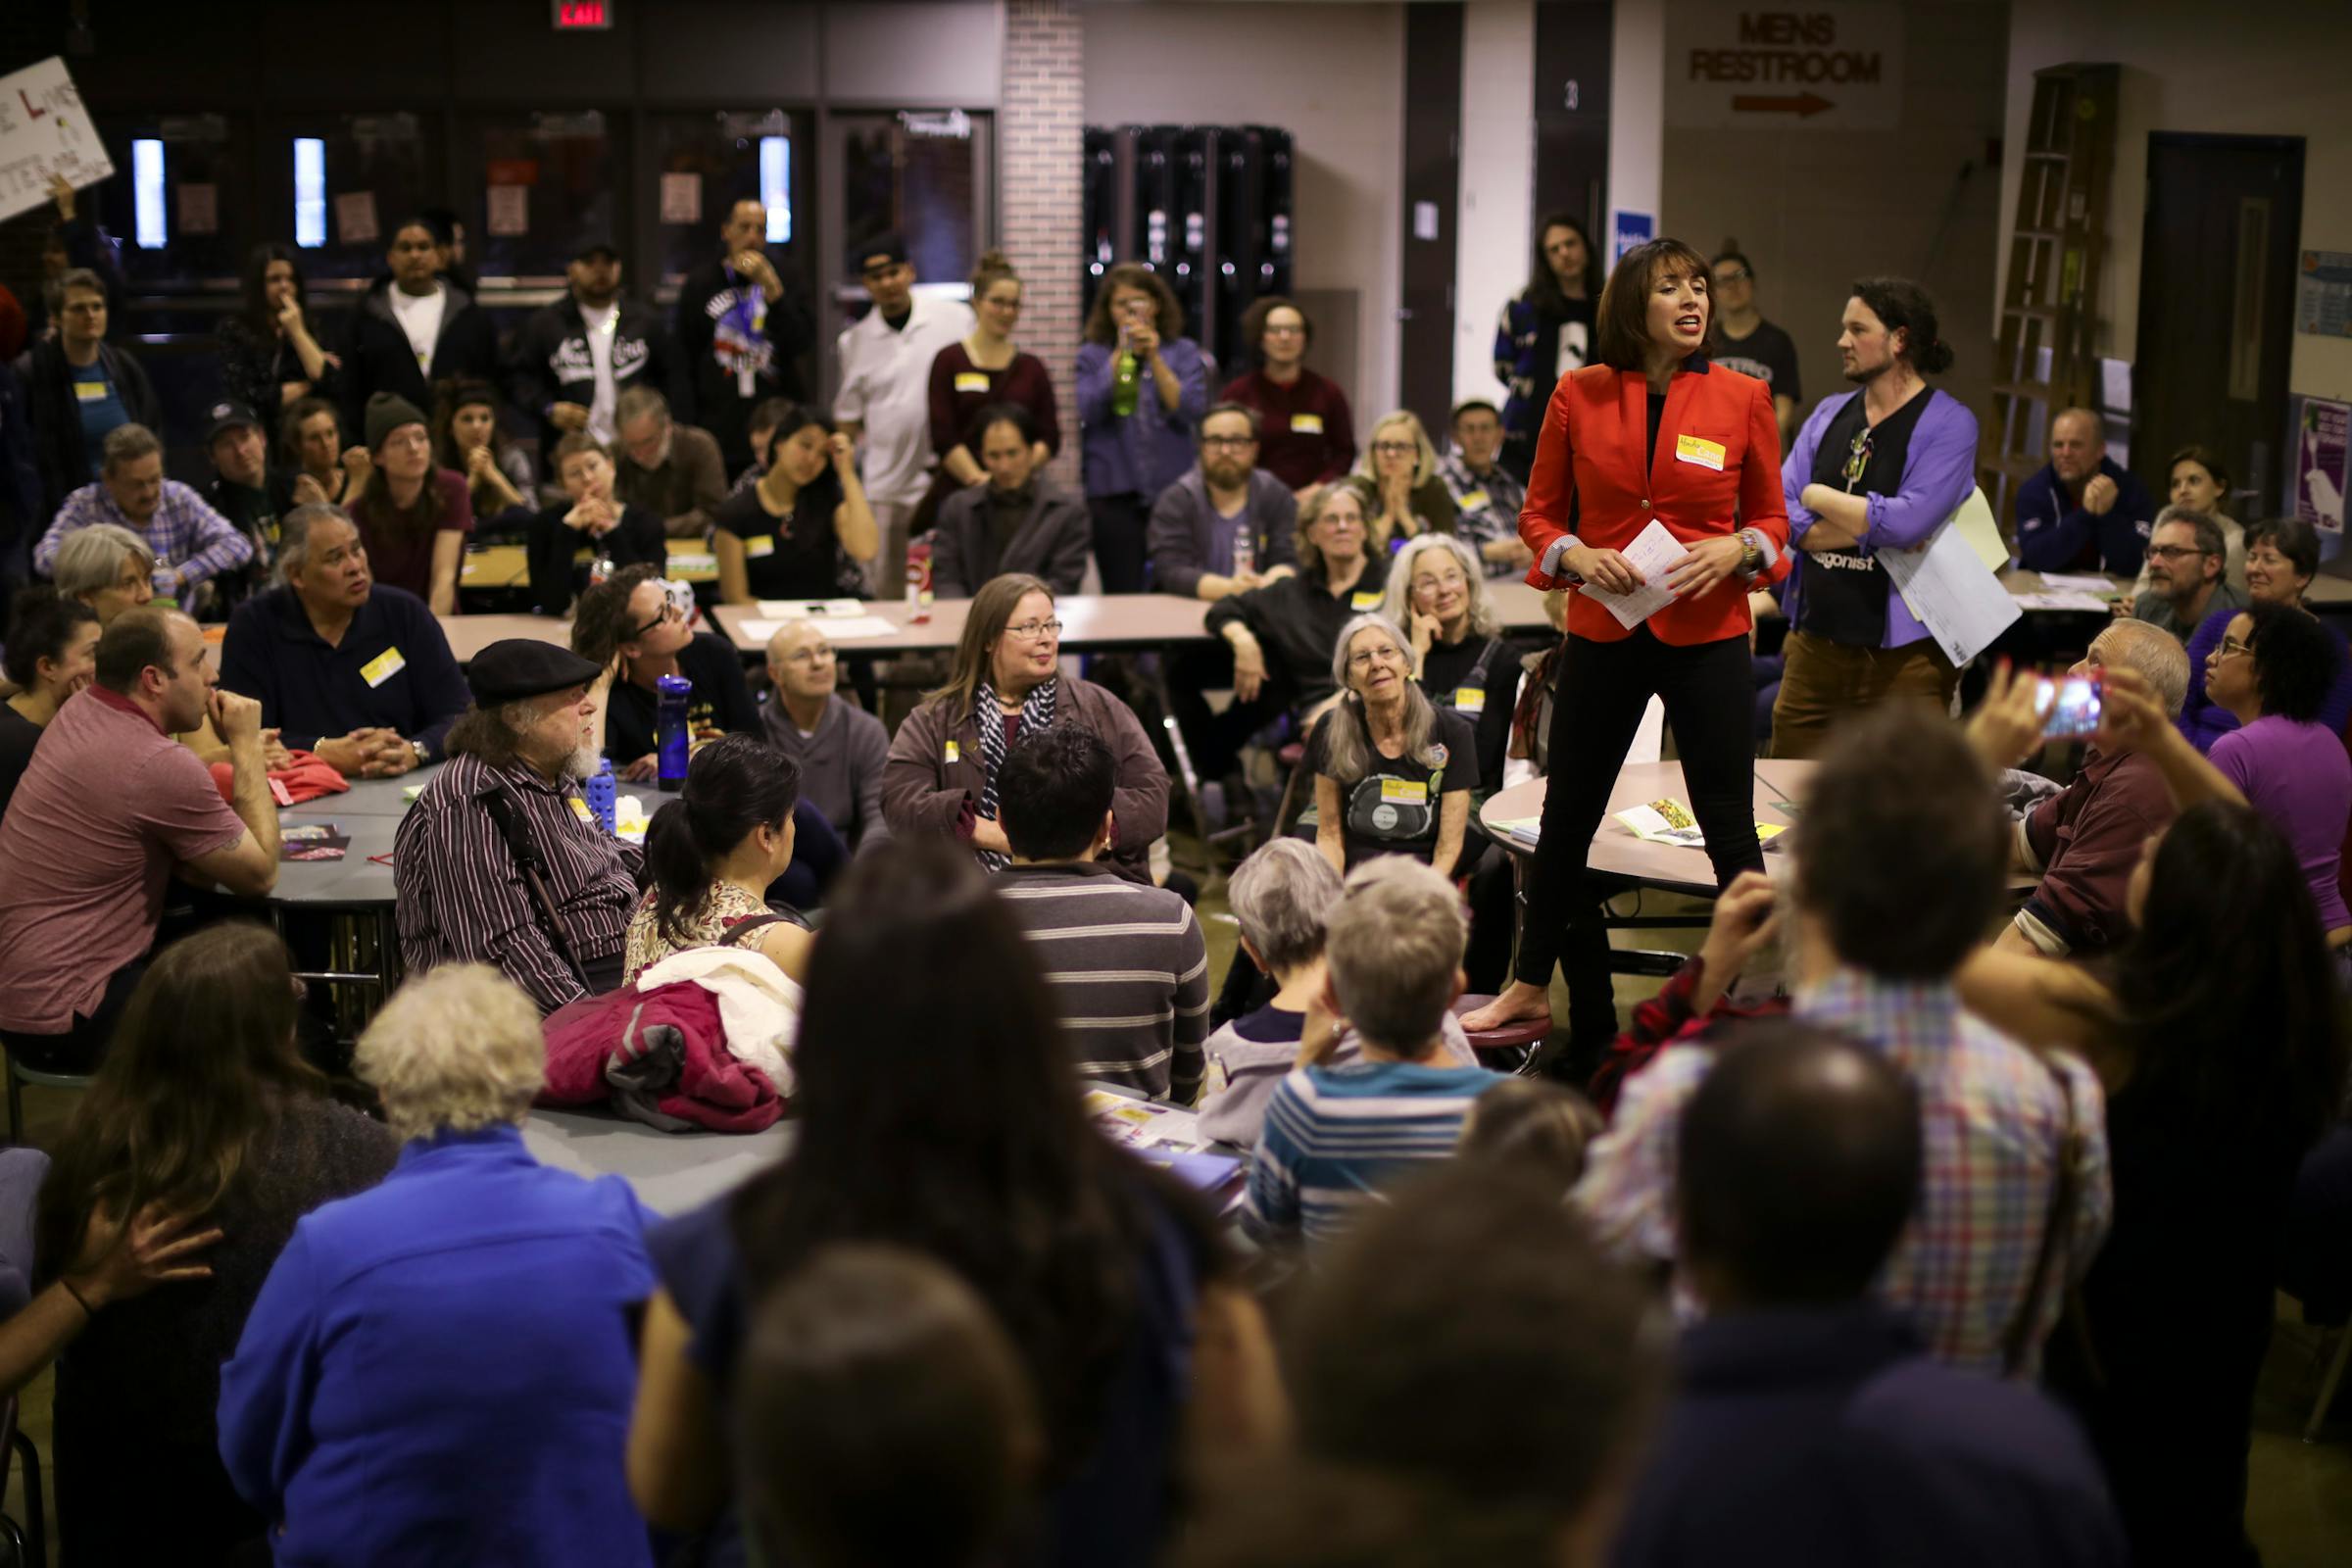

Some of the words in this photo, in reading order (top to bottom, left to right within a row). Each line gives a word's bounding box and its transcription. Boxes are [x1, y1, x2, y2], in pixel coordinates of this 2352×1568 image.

[1739, 12, 1837, 45] MENS
[1690, 48, 1882, 83] RESTROOM
[1565, 79, 1579, 110] 3
[1811, 552, 1875, 571] agonist
